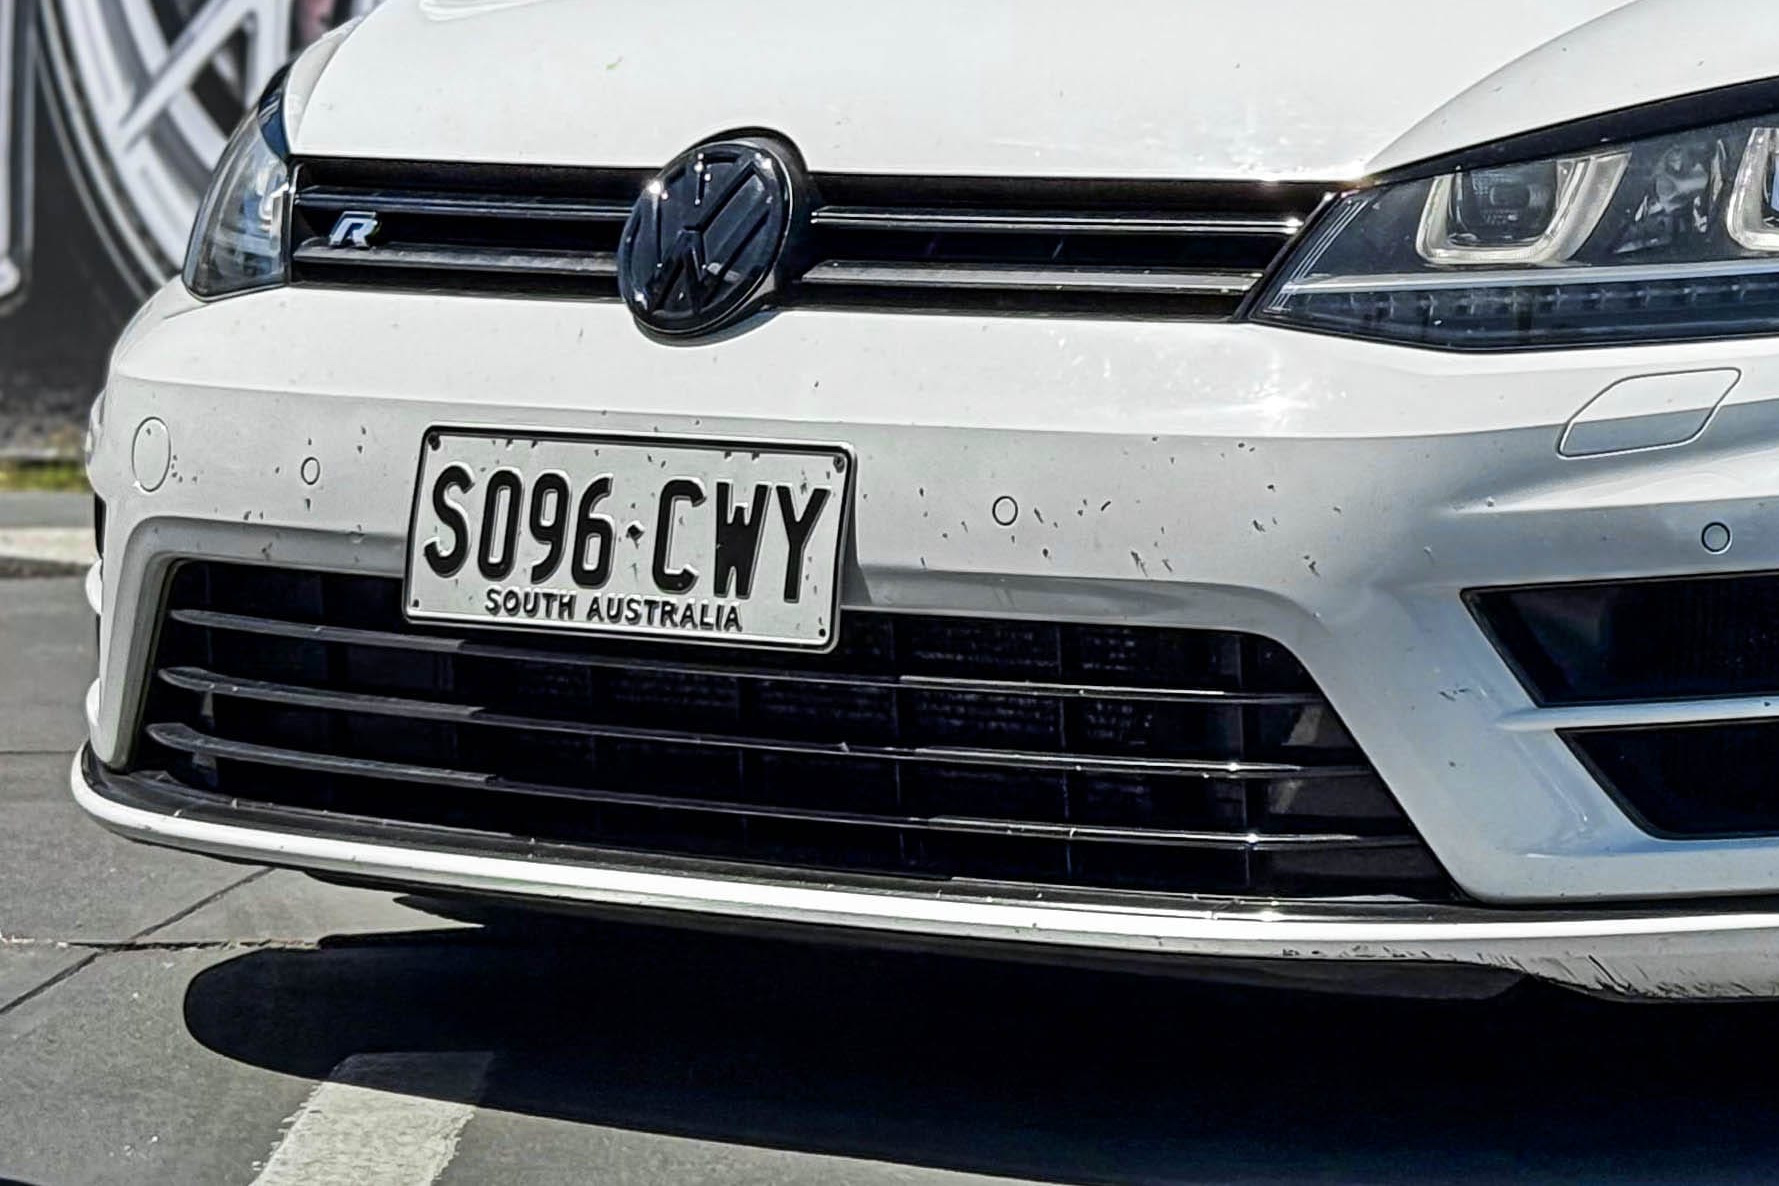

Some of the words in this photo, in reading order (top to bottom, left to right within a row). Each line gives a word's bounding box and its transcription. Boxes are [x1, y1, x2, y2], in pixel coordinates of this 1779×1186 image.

[328, 210, 378, 248] R
[484, 588, 576, 619] SOUTH
[587, 598, 743, 633] AUSTRALIA
